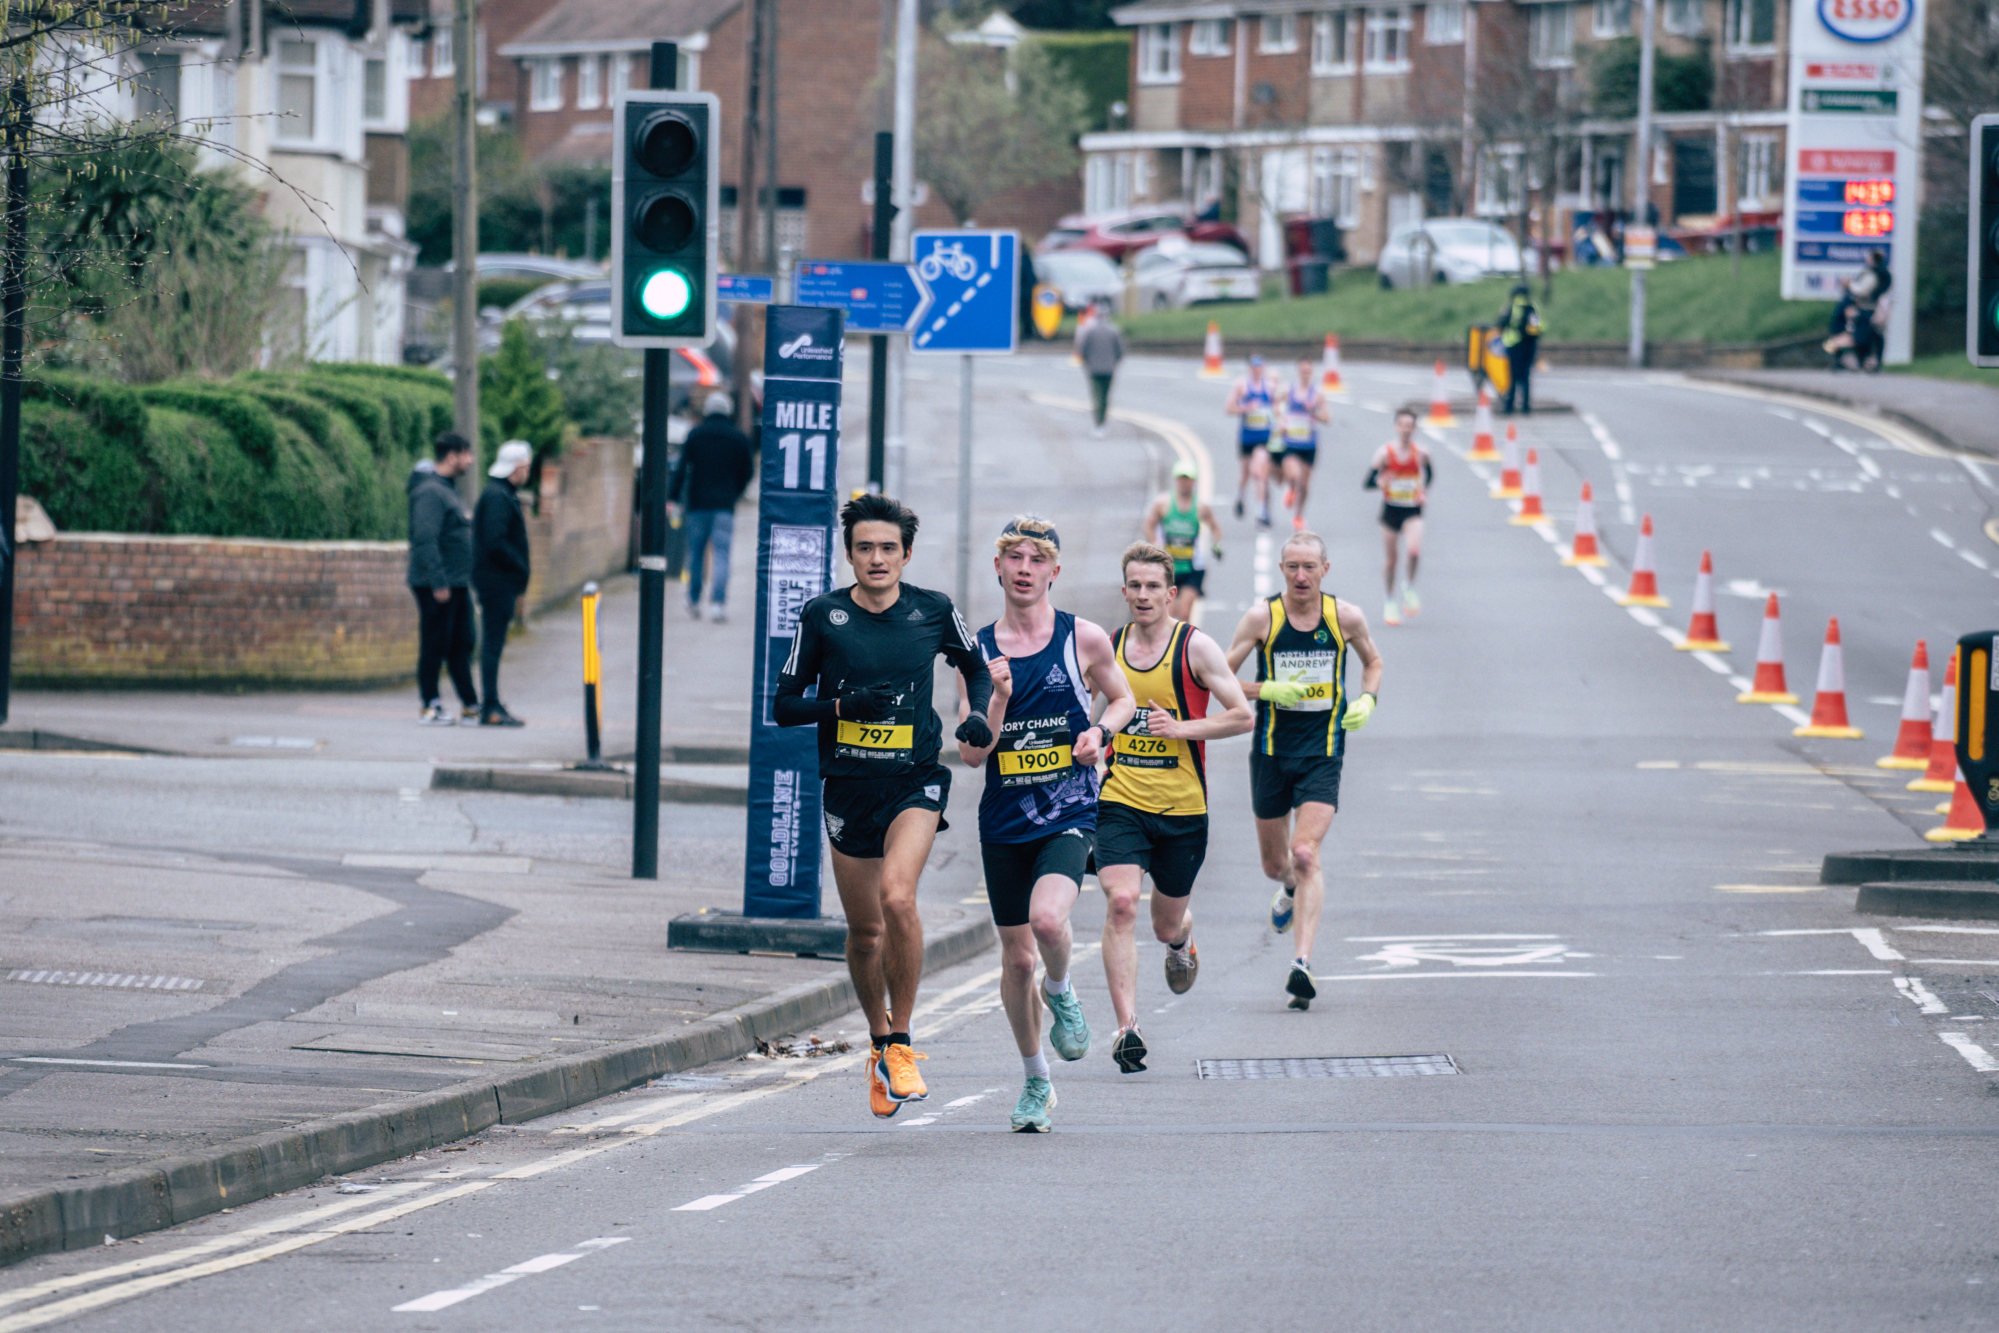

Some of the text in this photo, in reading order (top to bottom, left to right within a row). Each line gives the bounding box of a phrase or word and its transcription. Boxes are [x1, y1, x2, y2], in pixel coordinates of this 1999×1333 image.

[793, 353, 833, 361] Performance
[801, 347, 833, 355] Unleashed
[776, 402, 832, 430] MILE
[779, 434, 827, 490] 11
[777, 579, 788, 630] READING
[788, 580, 804, 630] HALF
[1280, 659, 1327, 669] ANDREW
[1000, 717, 1066, 732] RORY CHANG
[859, 728, 894, 744] 797
[1128, 738, 1167, 753] 4276
[1017, 751, 1060, 769] 1900
[769, 768, 794, 887] GOLDLINE
[790, 799, 802, 857] EVENTS
